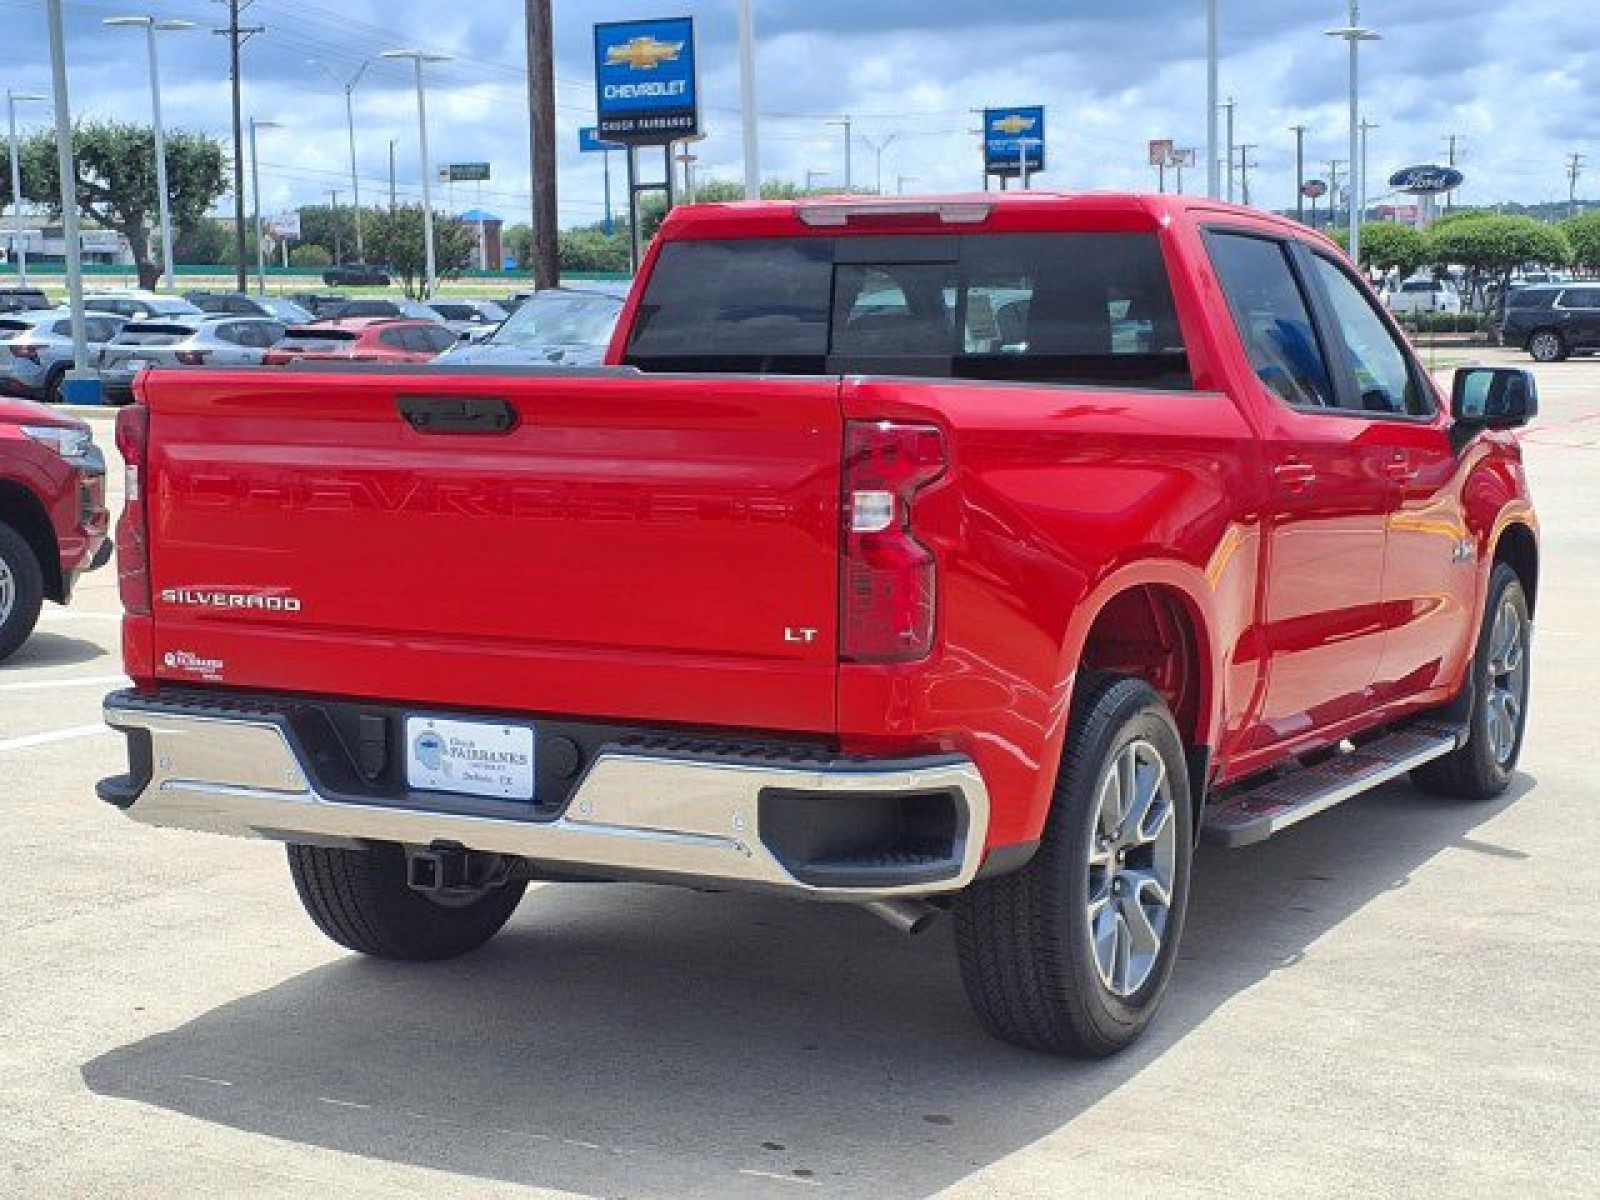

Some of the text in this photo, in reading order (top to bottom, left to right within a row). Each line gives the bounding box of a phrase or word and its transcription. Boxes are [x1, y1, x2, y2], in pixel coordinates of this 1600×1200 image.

[604, 80, 686, 98] CHEVROLET
[1404, 171, 1447, 189] Ford
[161, 589, 301, 611] SILVERADO
[784, 627, 818, 644] LT
[449, 747, 529, 766] FAIRBANKS
